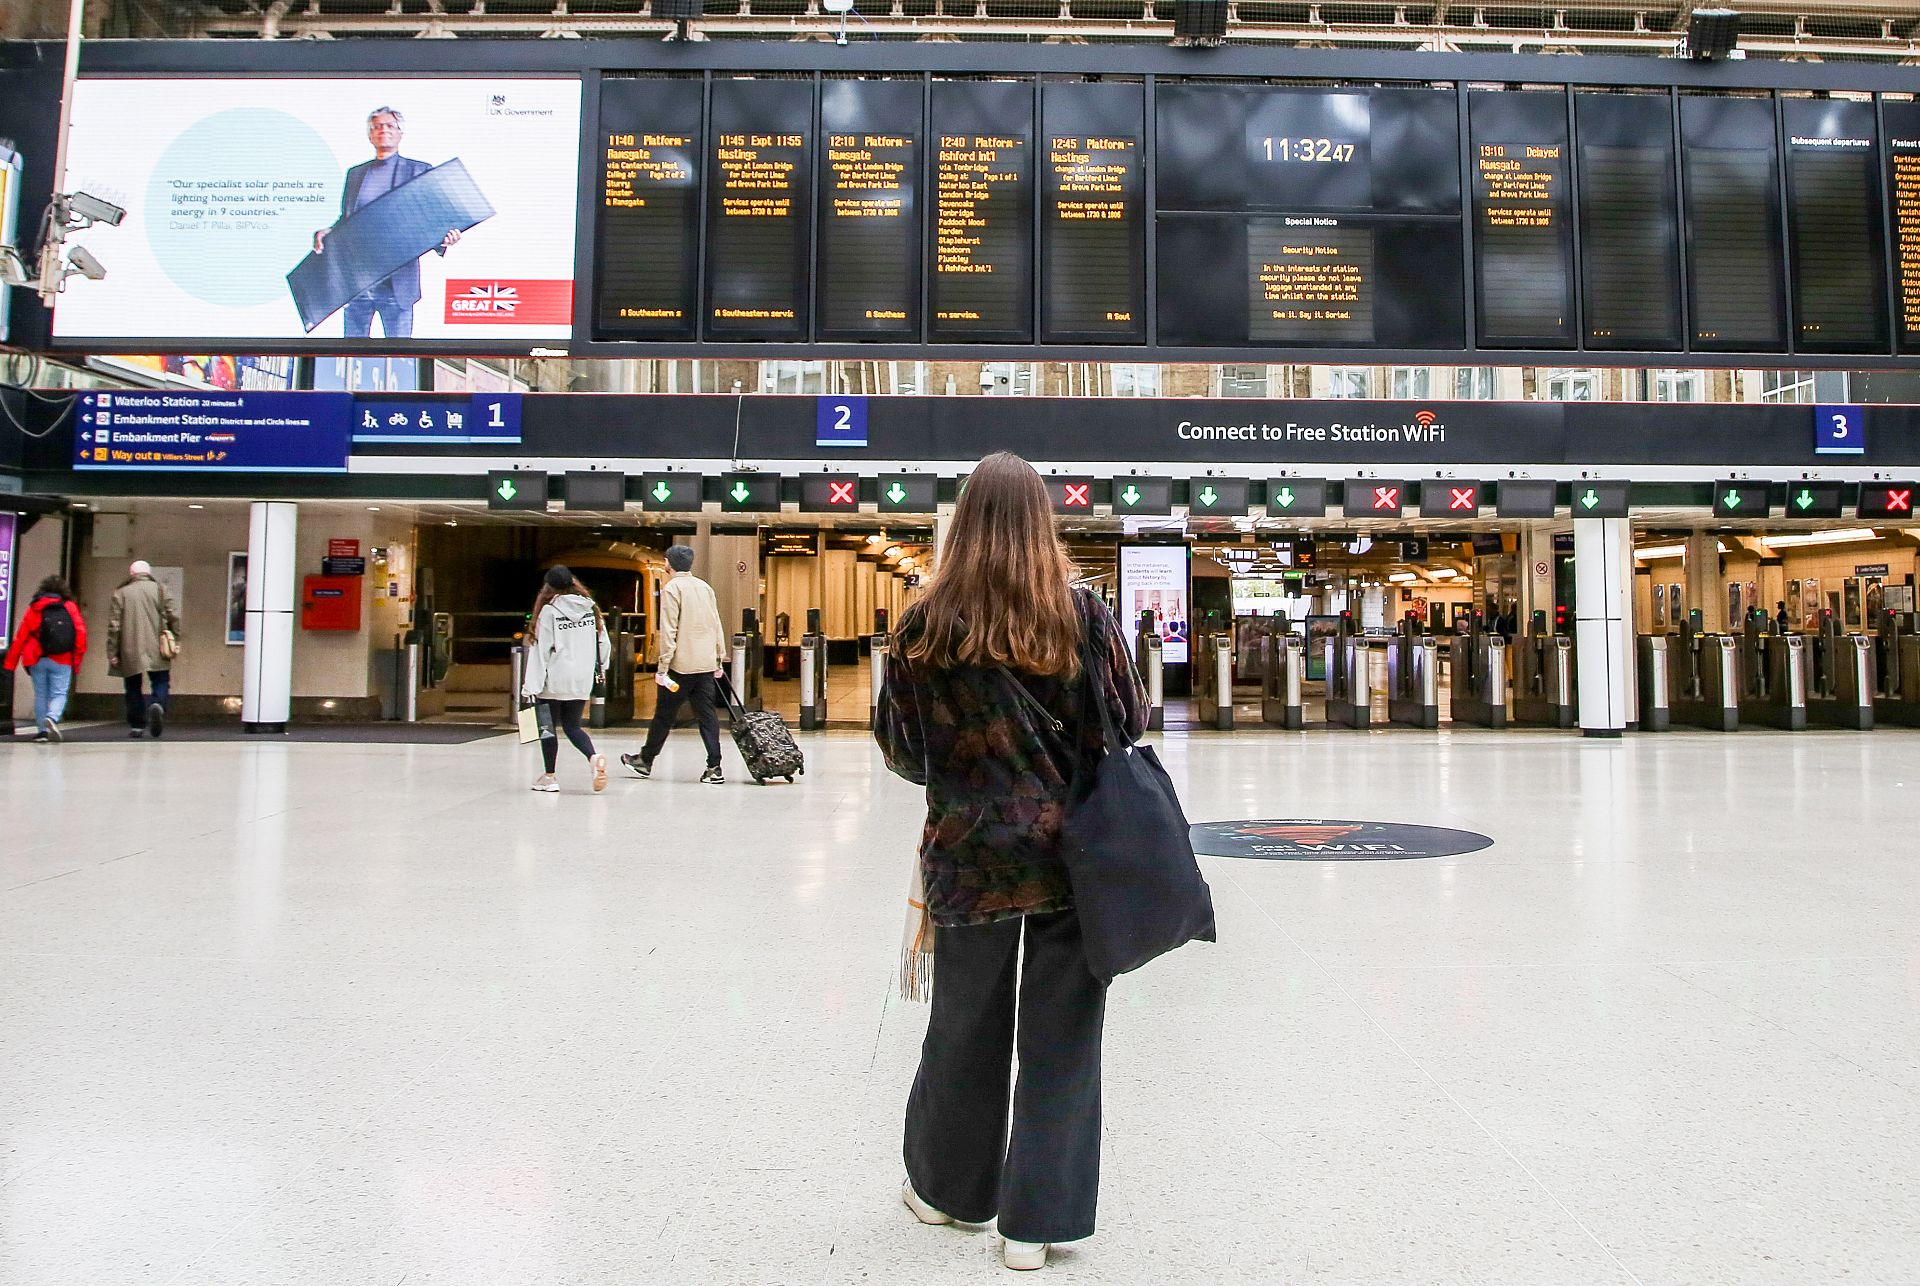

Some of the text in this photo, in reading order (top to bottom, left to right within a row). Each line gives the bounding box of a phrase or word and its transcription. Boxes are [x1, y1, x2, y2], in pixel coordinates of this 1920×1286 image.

[609, 135, 681, 146] 11:40 Platform
[720, 135, 802, 147] 11:45 Expt 11:55
[830, 136, 902, 147] 12:10 Platform
[940, 138, 1013, 148] 12:40 Platform
[1052, 139, 1124, 149] 12:45 Platform
[1791, 137, 1870, 147] Subsequent departures
[608, 149, 650, 160] Ramsgate
[718, 149, 757, 160] Hastings
[829, 150, 871, 161] Ramsgate
[939, 151, 975, 161] Ashford
[1480, 146, 1559, 158] 13:10 Delayed
[1051, 153, 1089, 163] Hastings
[621, 162, 660, 170] Canterbury
[954, 164, 988, 172] Tonbridge
[1480, 160, 1520, 171] Ramsgate
[197, 180, 242, 191] specialist
[245, 180, 269, 188] solar
[273, 180, 303, 191] panels
[972, 182, 988, 190] East
[172, 194, 325, 204] lighting homes with renewable
[965, 191, 989, 199] Bridge
[171, 209, 205, 218] energy
[1285, 218, 1312, 226] Special
[938, 237, 980, 245] Staplehurst
[938, 246, 970, 254] Headcorn
[1282, 246, 1313, 255] Security
[938, 256, 968, 264] Pluckley
[1260, 274, 1290, 282] security
[451, 300, 491, 310] GREAT
[115, 397, 161, 407] Waterloo
[162, 397, 199, 407] Station
[114, 414, 180, 425] Embankment
[182, 415, 218, 425] Station
[489, 403, 504, 426] 1
[834, 405, 851, 429] 2
[1832, 415, 1847, 438] 3
[113, 432, 201, 442] Embankment Pier
[1178, 422, 1445, 442] Connect to Free Station WiFi
[112, 450, 132, 461] Way
[135, 451, 151, 460] out
[1411, 542, 1418, 555] 3
